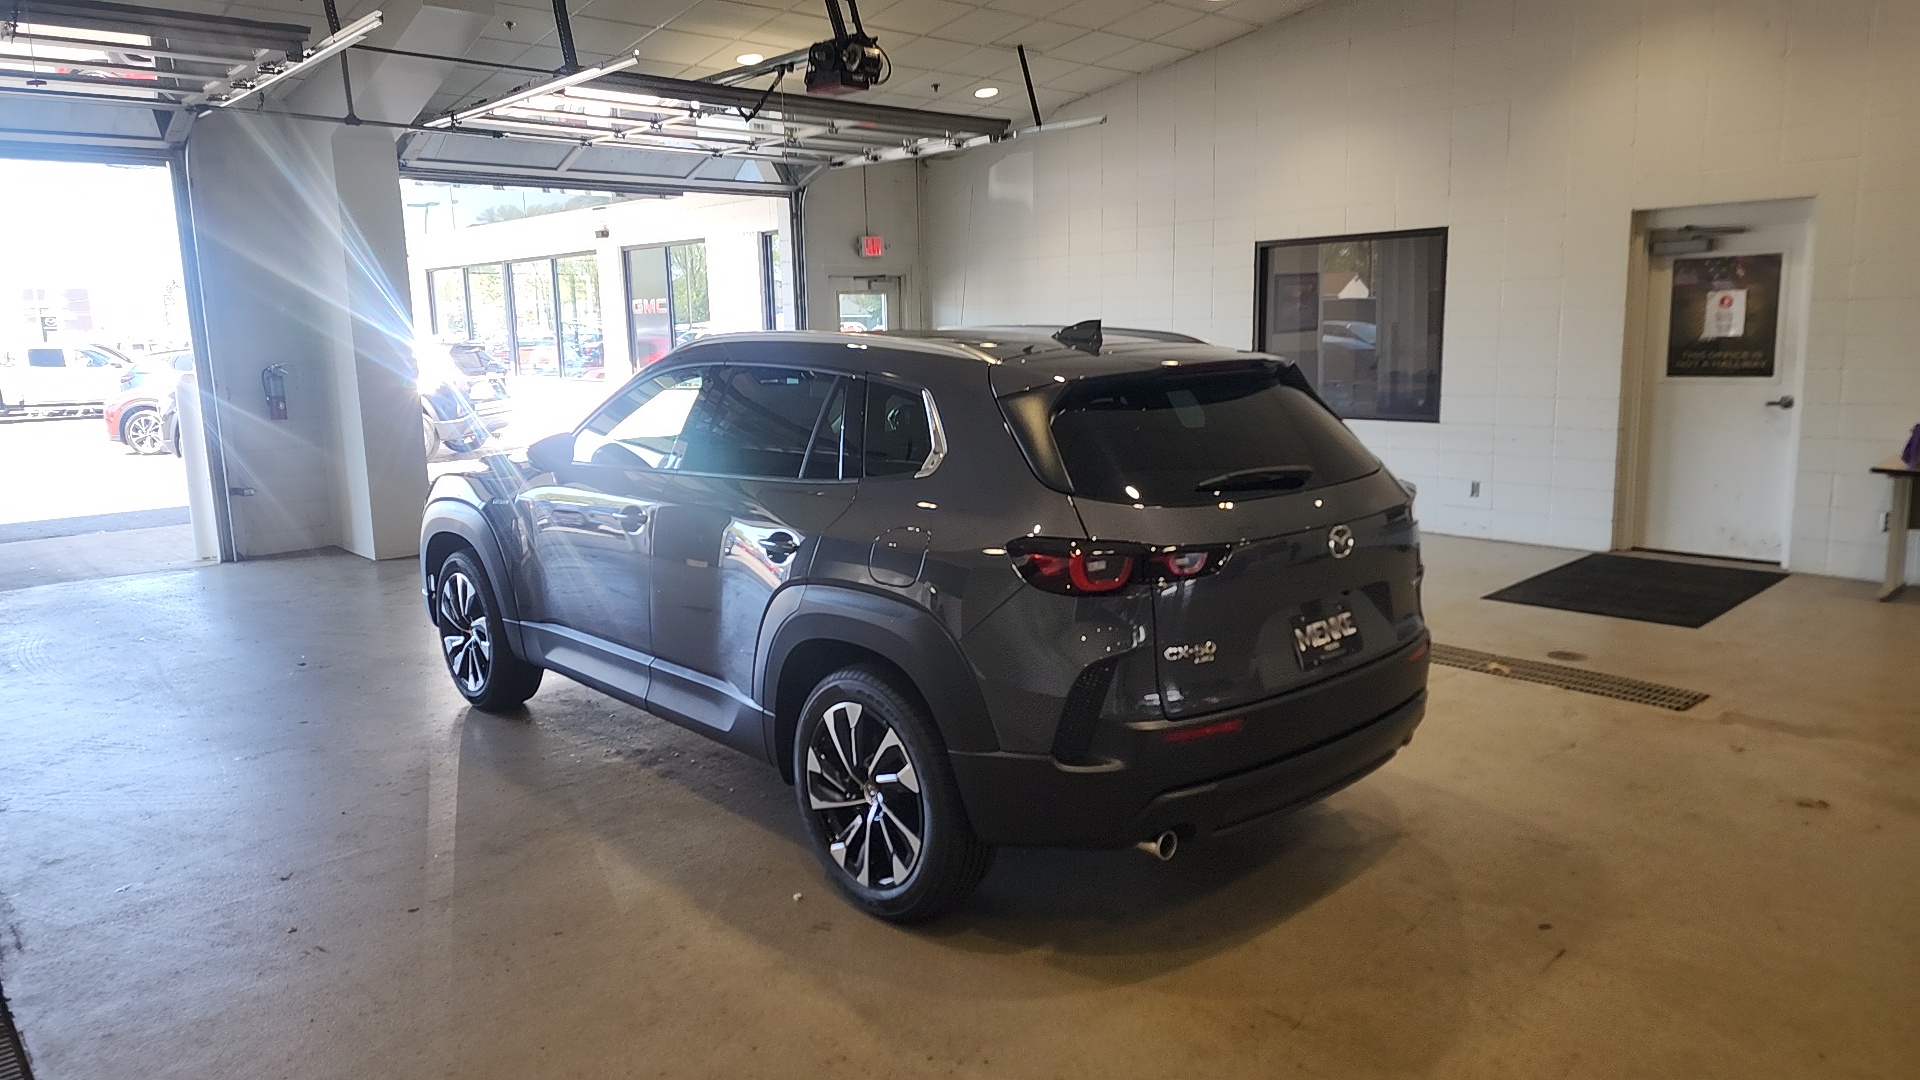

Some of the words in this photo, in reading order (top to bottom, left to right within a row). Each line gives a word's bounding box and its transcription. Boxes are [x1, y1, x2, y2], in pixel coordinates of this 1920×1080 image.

[632, 297, 668, 315] GMC
[1294, 611, 1357, 652] MENKE
[1163, 640, 1217, 660] CX-50
